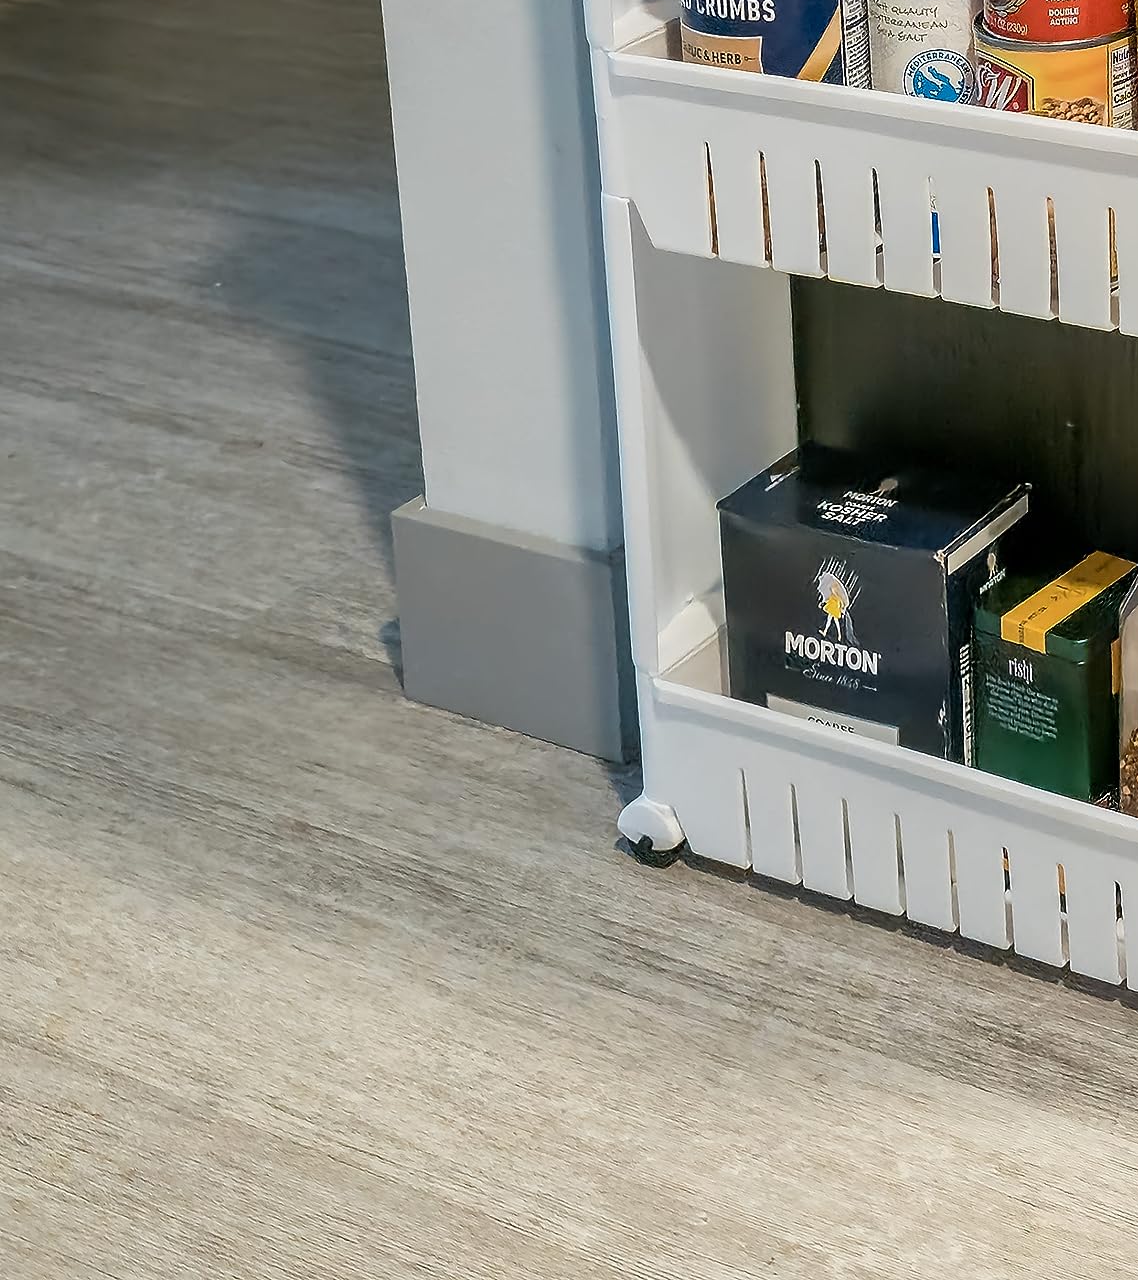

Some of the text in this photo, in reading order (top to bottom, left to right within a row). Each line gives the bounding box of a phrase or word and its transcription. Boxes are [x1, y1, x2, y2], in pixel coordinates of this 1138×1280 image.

[891, 6, 938, 18] QUALITY
[1048, 7, 1080, 16] DOUBLE
[1050, 17, 1079, 26] ACTING
[898, 31, 928, 42] SALT
[712, 50, 742, 65] HERB
[908, 51, 971, 78] MEDITERRANEAN
[843, 491, 898, 507] MORTON
[817, 500, 888, 522] KOSHER
[821, 512, 866, 526] SALT
[785, 631, 878, 675] MORTON
[803, 663, 833, 681] Since
[1008, 657, 1033, 685] rishi
